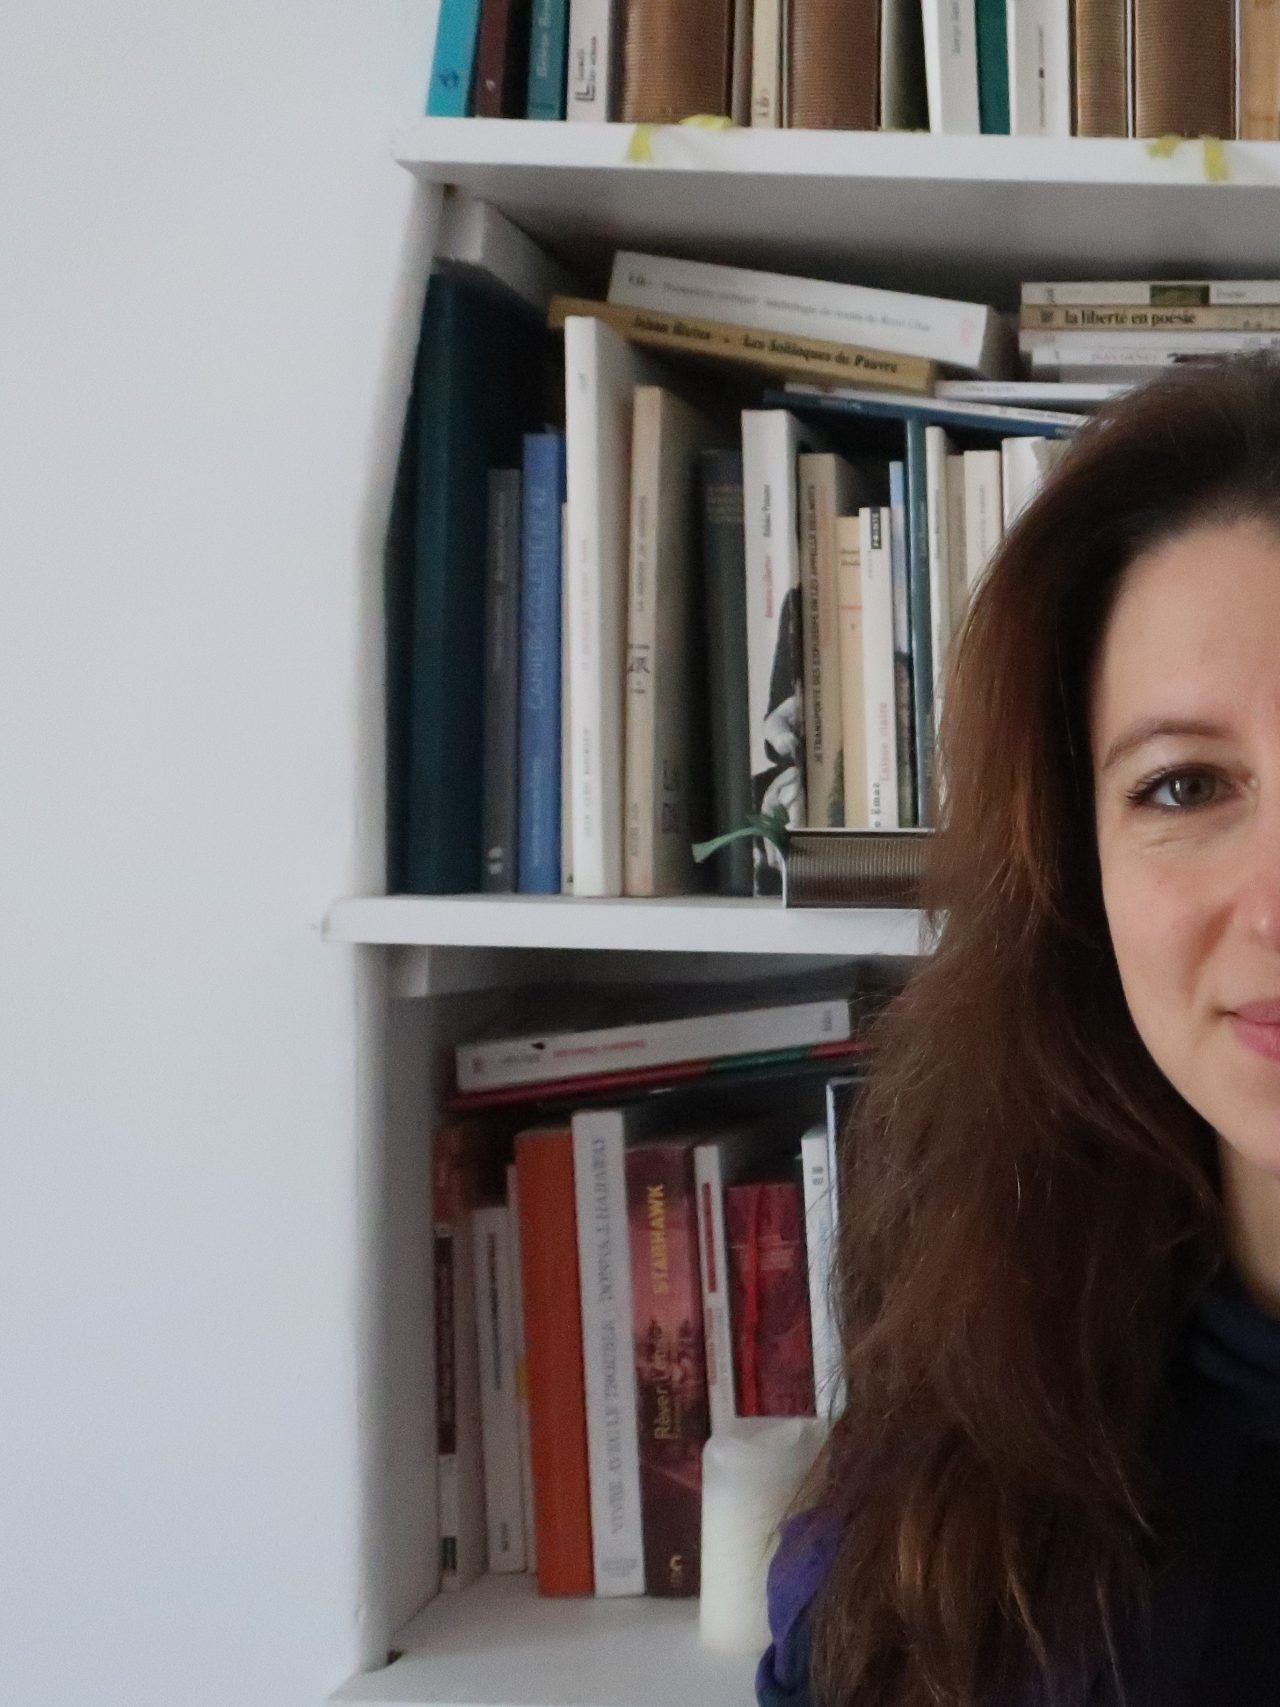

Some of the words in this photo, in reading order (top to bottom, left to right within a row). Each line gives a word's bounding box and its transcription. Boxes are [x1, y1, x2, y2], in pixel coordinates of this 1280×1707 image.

[1065, 310, 1078, 324] la
[1081, 310, 1128, 325] liberté
[1131, 314, 1147, 324] en
[1151, 310, 1196, 327] poésie
[855, 353, 898, 374] Pauvre
[529, 622, 545, 710] CAHIERS
[812, 688, 823, 751] TRANSPORTE
[592, 1138, 610, 1219] HARAWAY
[647, 1184, 671, 1295] STARHAWK
[597, 1240, 613, 1301] DONNA
[605, 1407, 620, 1427] LE
[652, 1388, 671, 1439] Rêver
[608, 1483, 625, 1534] VIVRE
